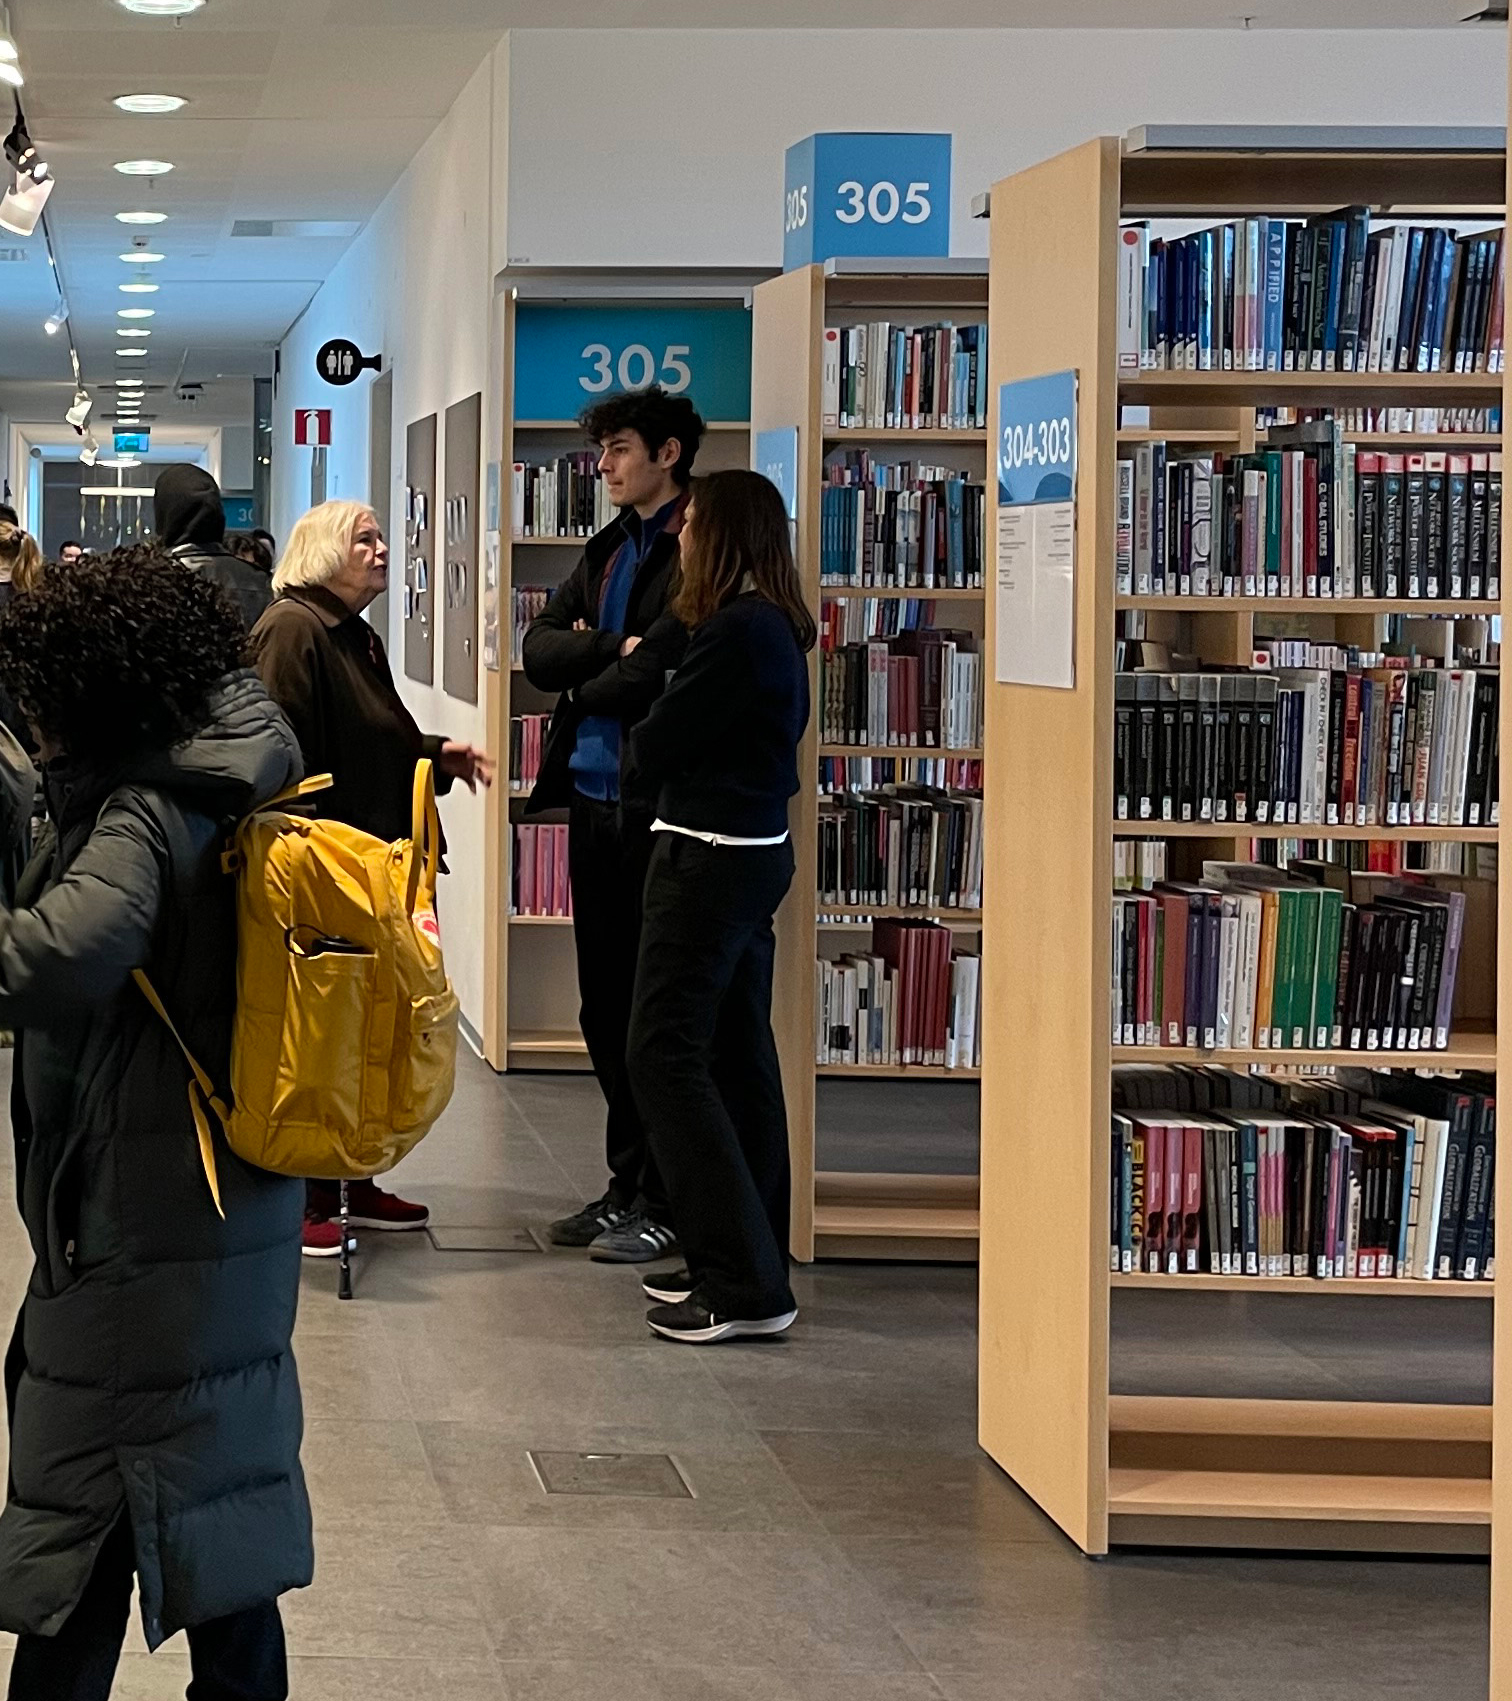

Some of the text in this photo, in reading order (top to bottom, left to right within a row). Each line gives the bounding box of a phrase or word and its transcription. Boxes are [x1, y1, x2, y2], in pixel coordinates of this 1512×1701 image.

[786, 185, 807, 233] 305
[835, 181, 931, 224] 305
[578, 343, 691, 394] 305
[1002, 416, 1071, 470] 304-303
[1318, 482, 1327, 557] GLOBAL STUDIES
[1472, 500, 1482, 562] MILLENNIUM
[1489, 501, 1499, 563] MILLENNIUM
[1116, 523, 1130, 576] REVOLUTIO
[1415, 780, 1425, 803] COL
[1131, 1162, 1143, 1217] BLACK
[1442, 1143, 1460, 1220] GLOBALIZATION
[1466, 1144, 1485, 1221] GLOBALIZATION
